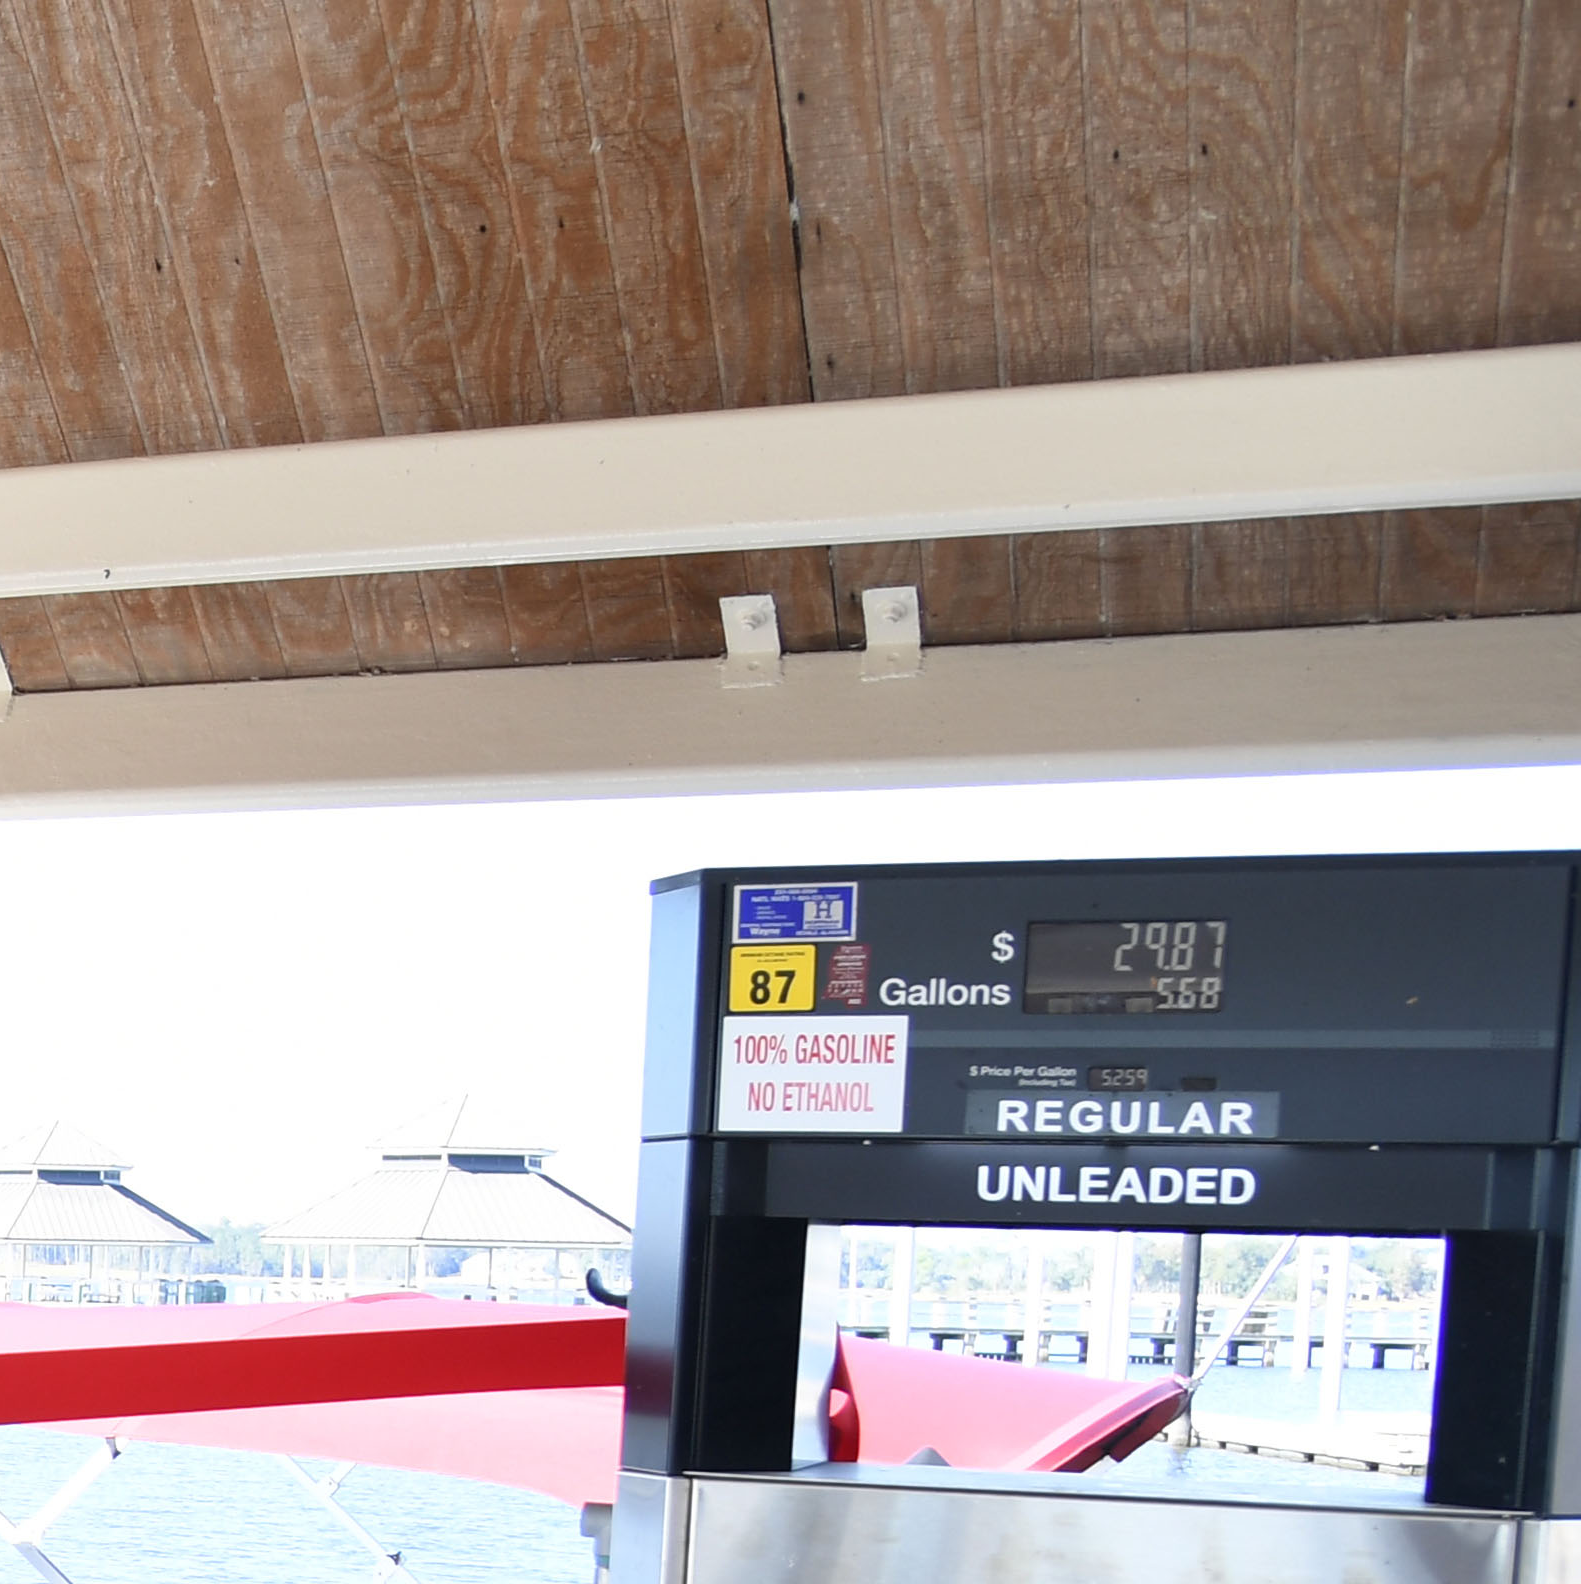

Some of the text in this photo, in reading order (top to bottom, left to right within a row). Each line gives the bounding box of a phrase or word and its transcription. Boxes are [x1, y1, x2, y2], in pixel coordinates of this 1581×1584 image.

[991, 930, 1015, 963] $
[1113, 921, 1227, 971] 29.87
[749, 969, 797, 1006] 87
[879, 977, 1011, 1006] Gallons
[734, 1034, 896, 1065] 100% GASOLINE
[981, 1065, 1011, 1077] Price
[1013, 1065, 1036, 1077] Per
[1037, 1066, 1077, 1077] Gallon
[747, 1081, 874, 1112] NO ETHANOL
[996, 1099, 1254, 1135] REGULAR
[976, 1164, 1257, 1205] UNLEADED
